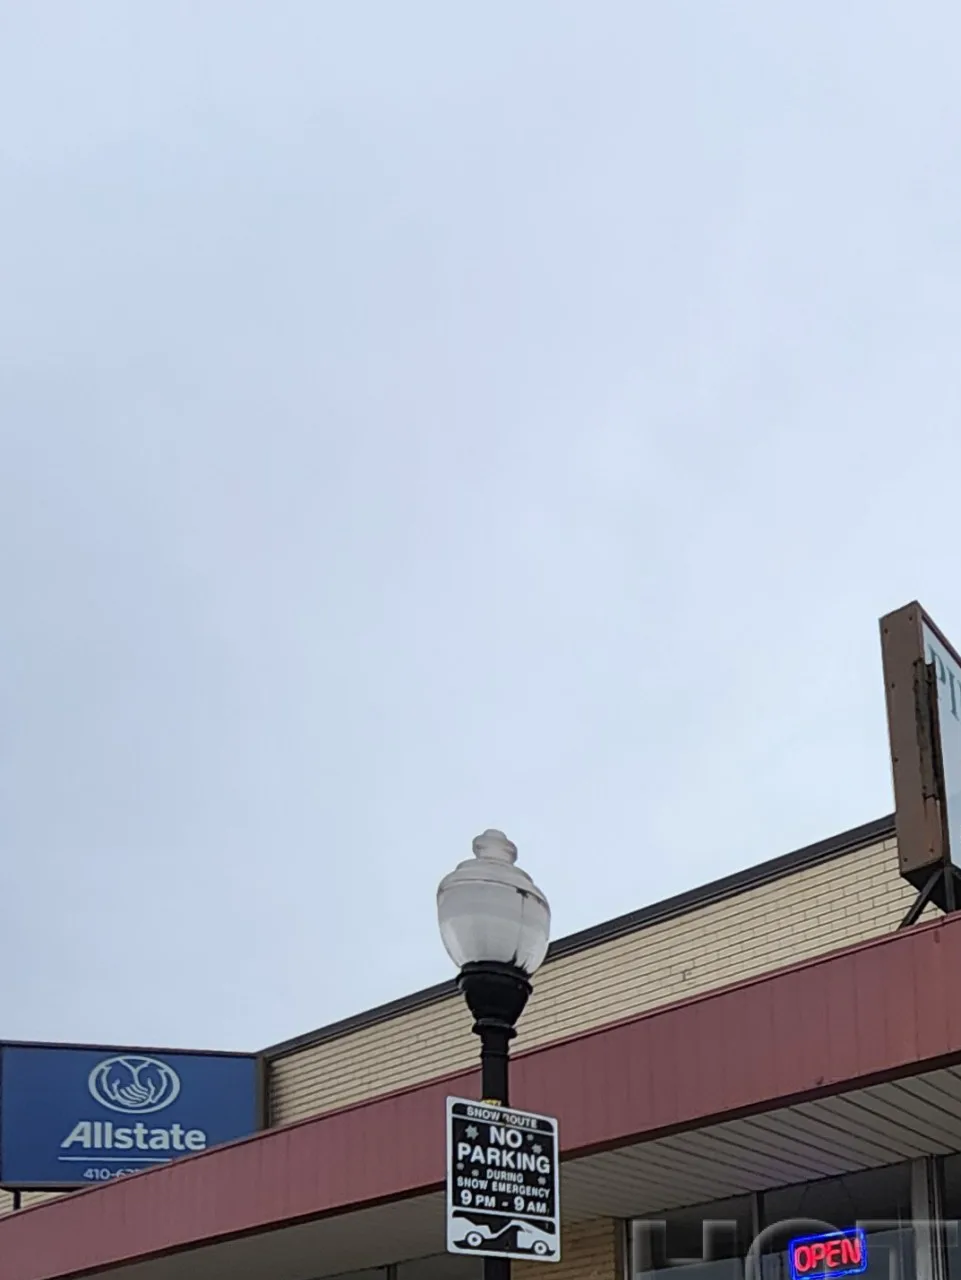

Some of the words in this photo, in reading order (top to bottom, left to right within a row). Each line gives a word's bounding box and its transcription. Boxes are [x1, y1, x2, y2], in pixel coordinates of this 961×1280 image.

[466, 1106, 500, 1121] SNOW
[502, 1113, 537, 1128] ROUTE
[60, 1121, 206, 1151] Allstate
[489, 1125, 523, 1148] NO
[457, 1142, 550, 1174] PARKING
[457, 1176, 488, 1190] SNOW
[492, 1181, 551, 1199] EMERGENCY
[486, 1168, 524, 1184] DURING
[460, 1189, 472, 1206] 9
[475, 1194, 496, 1208] PM
[513, 1195, 525, 1211] 9
[526, 1200, 547, 1214] AM
[794, 1237, 861, 1272] OPEN
